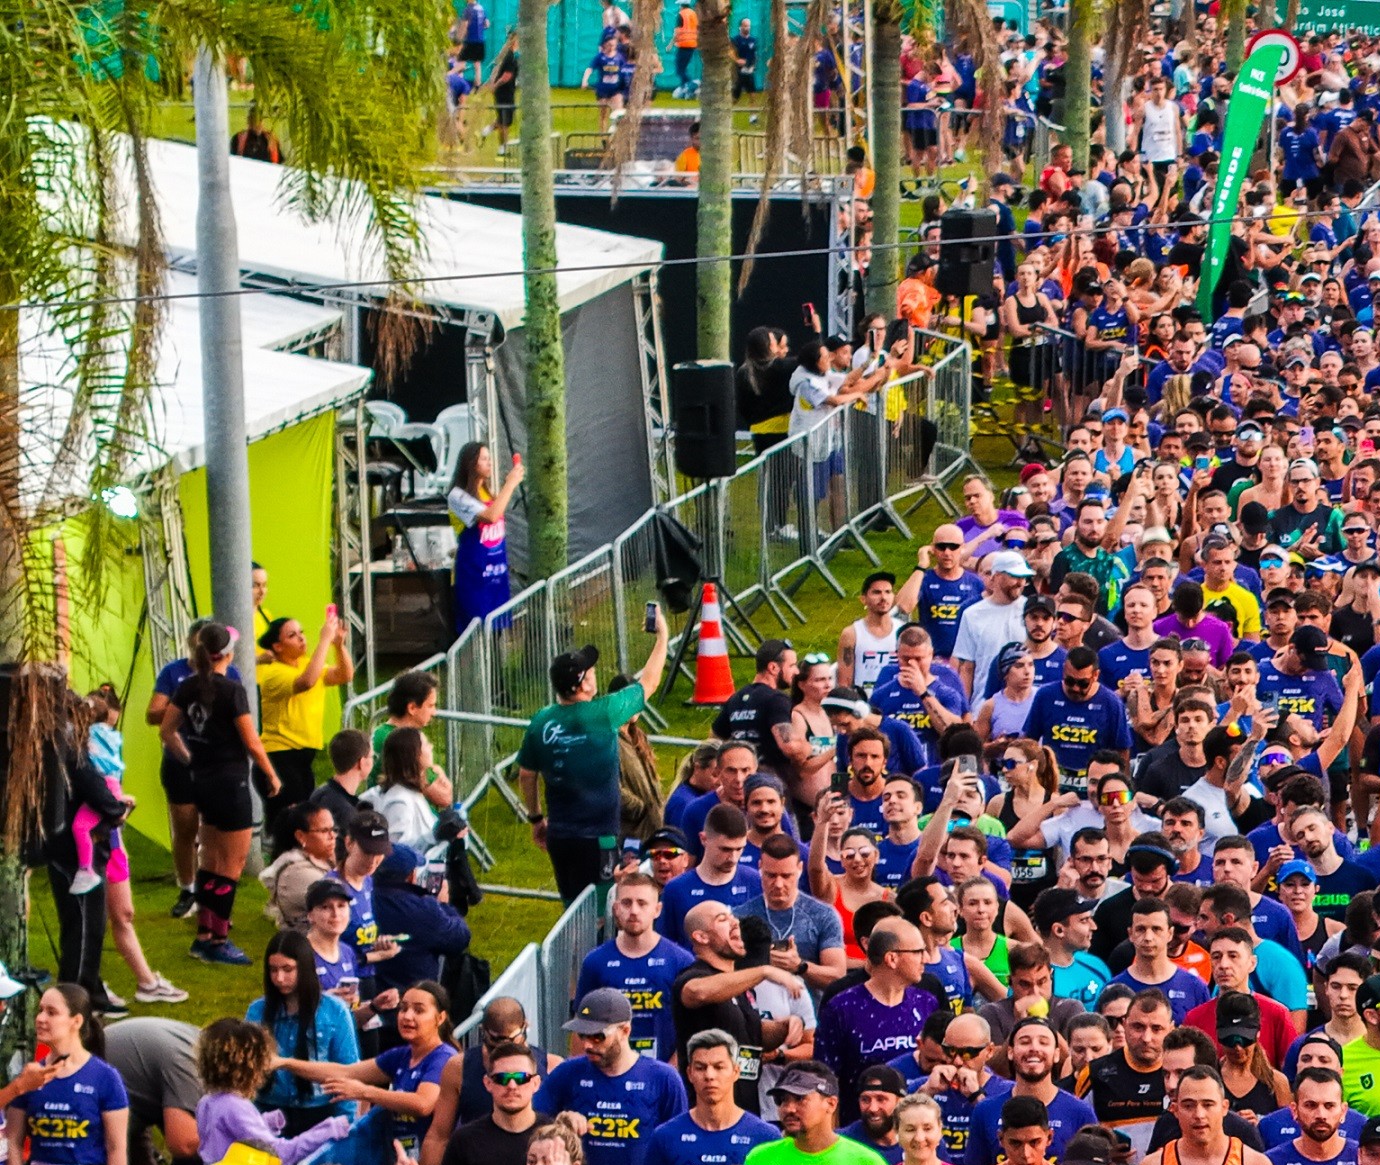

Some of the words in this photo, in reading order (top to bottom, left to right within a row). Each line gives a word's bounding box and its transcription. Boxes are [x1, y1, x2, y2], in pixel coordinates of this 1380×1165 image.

[930, 605, 959, 618] SC2
[1052, 725, 1097, 742] SC21K
[626, 992, 663, 1009] 21K
[590, 1117, 639, 1137] C21K
